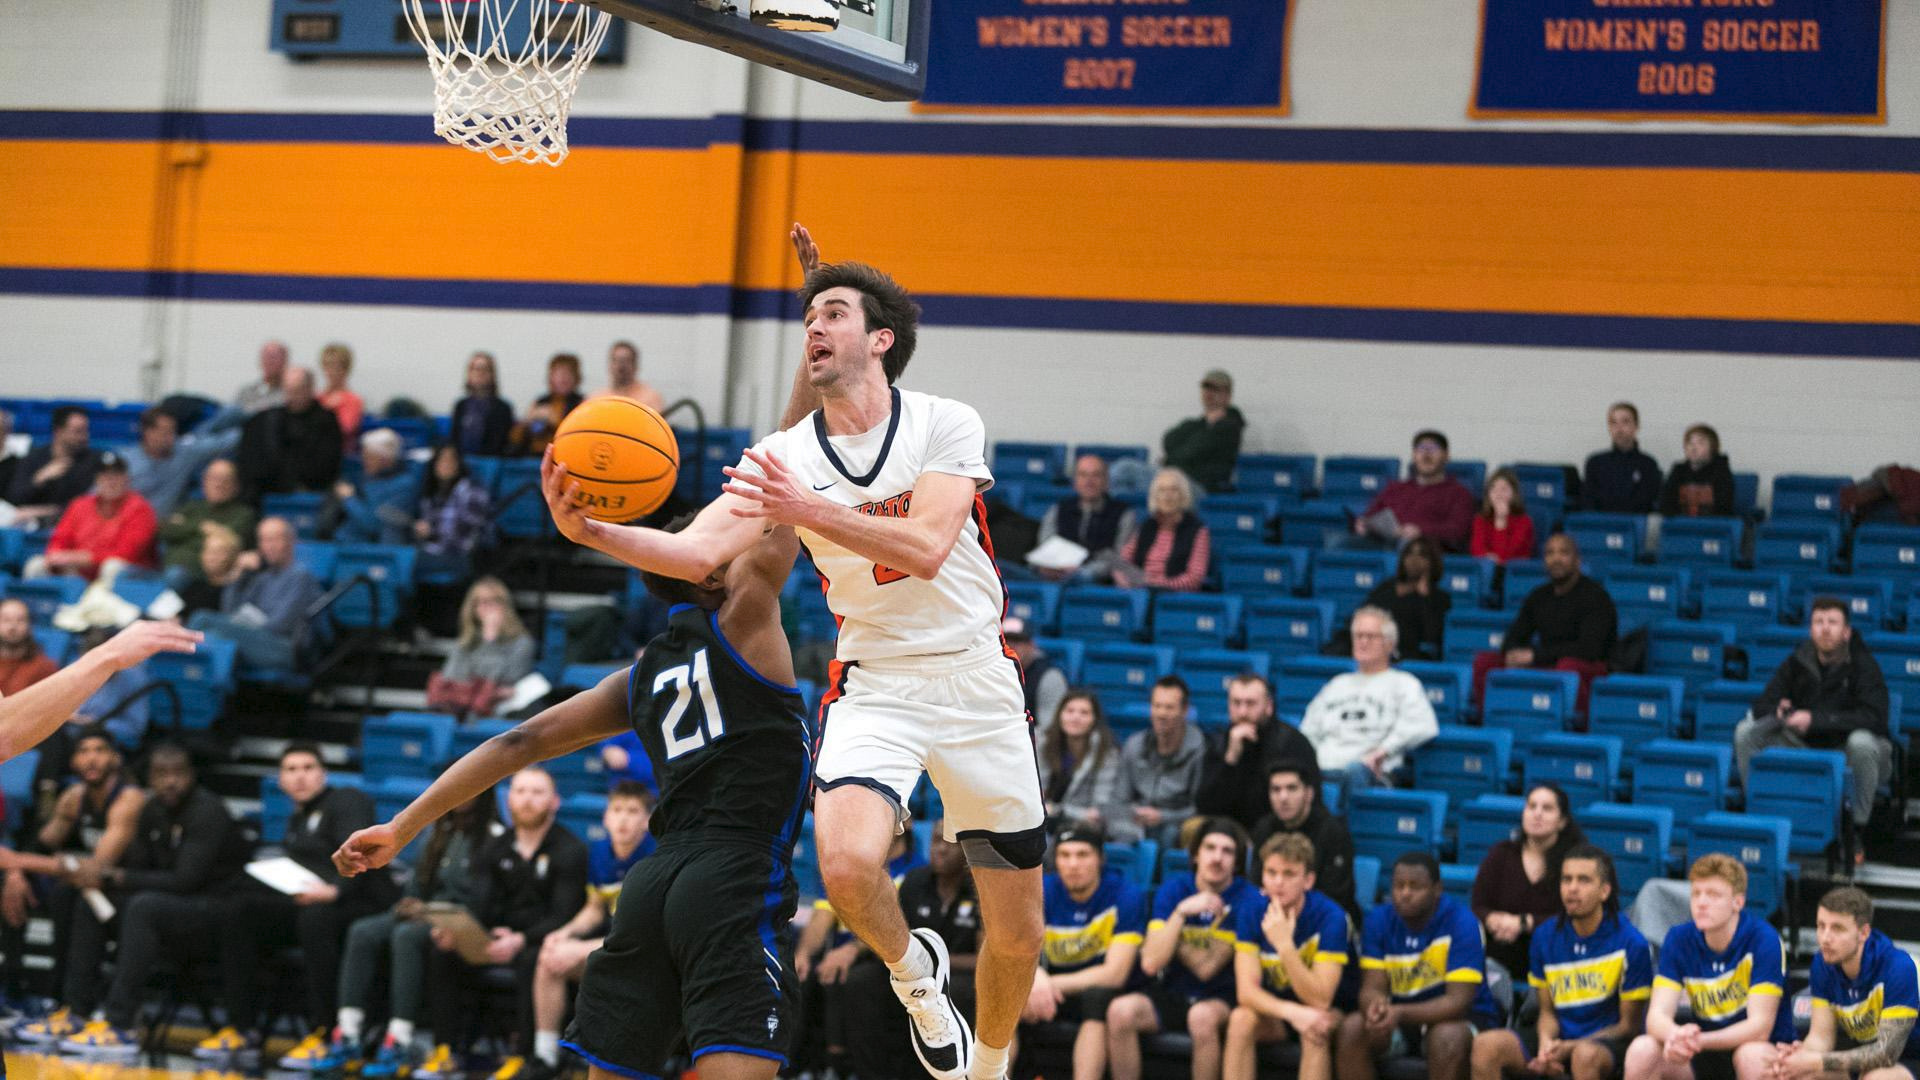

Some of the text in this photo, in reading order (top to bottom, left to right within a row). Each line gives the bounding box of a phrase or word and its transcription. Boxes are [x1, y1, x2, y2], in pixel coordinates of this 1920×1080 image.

[978, 16, 1231, 47] WOMEN'S SOCCER
[1544, 19, 1820, 52] WOMEN'S SOCCER
[1063, 59, 1136, 89] 2007
[1637, 63, 1716, 95] 2006
[652, 647, 725, 761] 21
